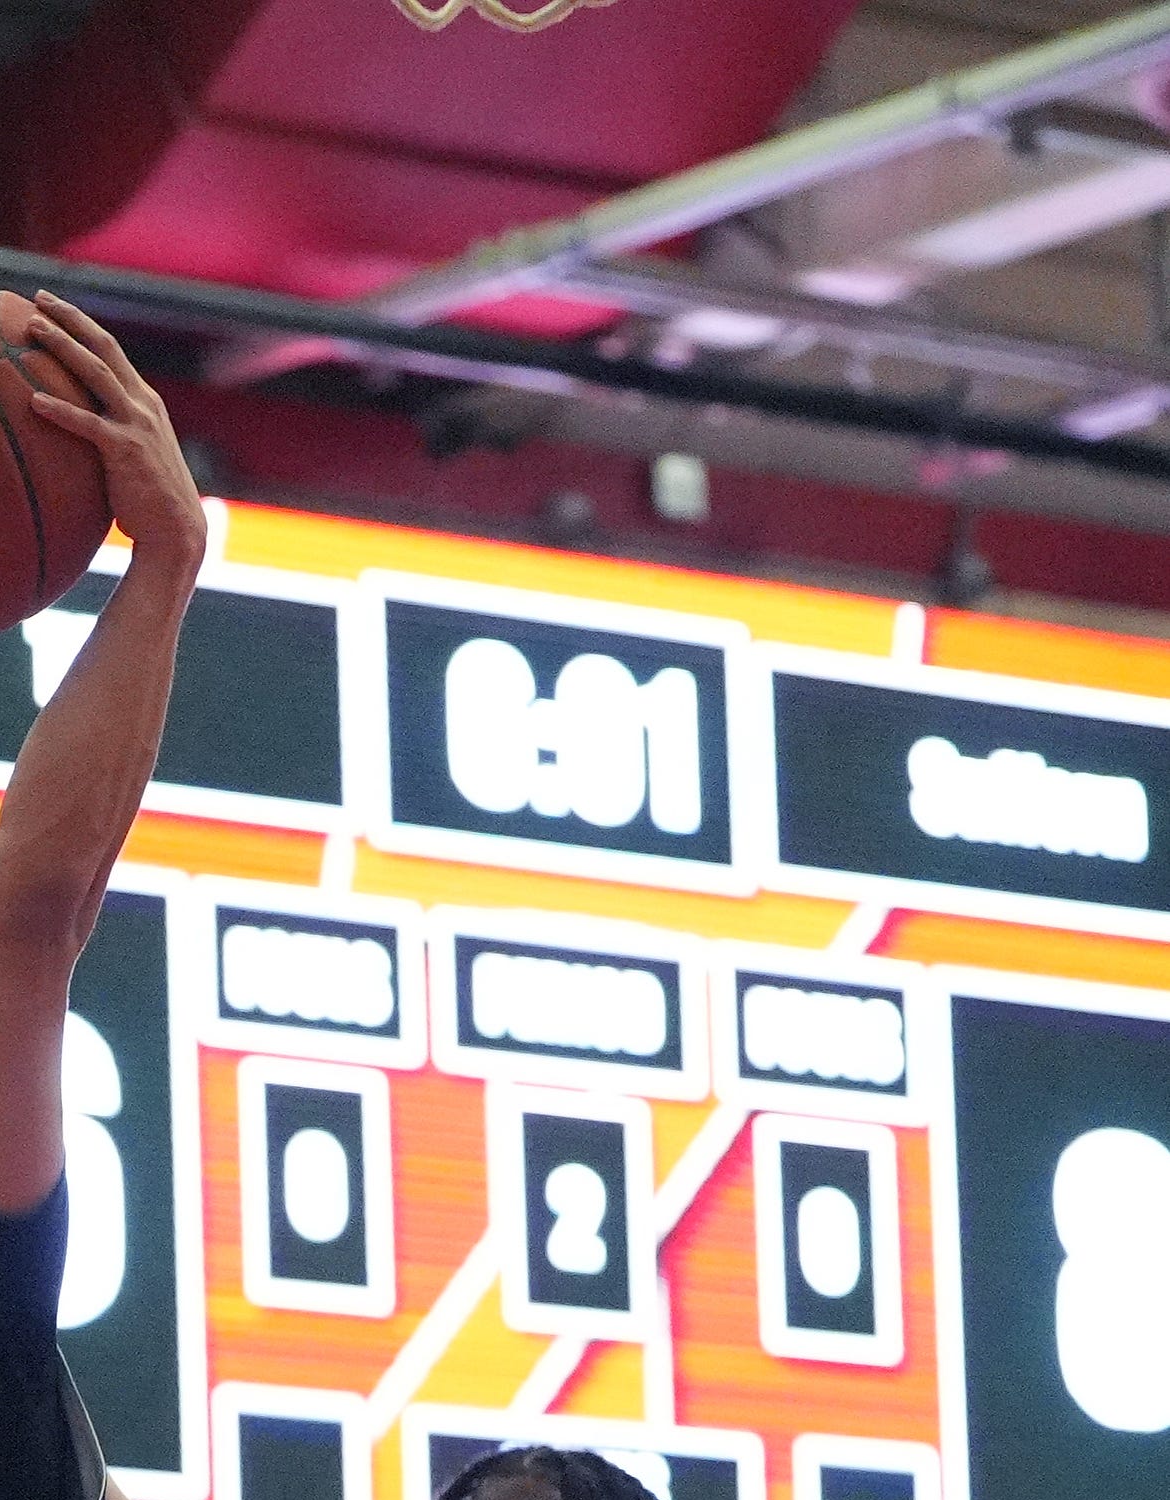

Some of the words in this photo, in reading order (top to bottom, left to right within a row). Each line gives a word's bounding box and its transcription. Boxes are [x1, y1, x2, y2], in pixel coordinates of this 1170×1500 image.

[284, 1130, 348, 1241] 0
[546, 1164, 606, 1273] 2
[798, 1187, 860, 1296] 0
